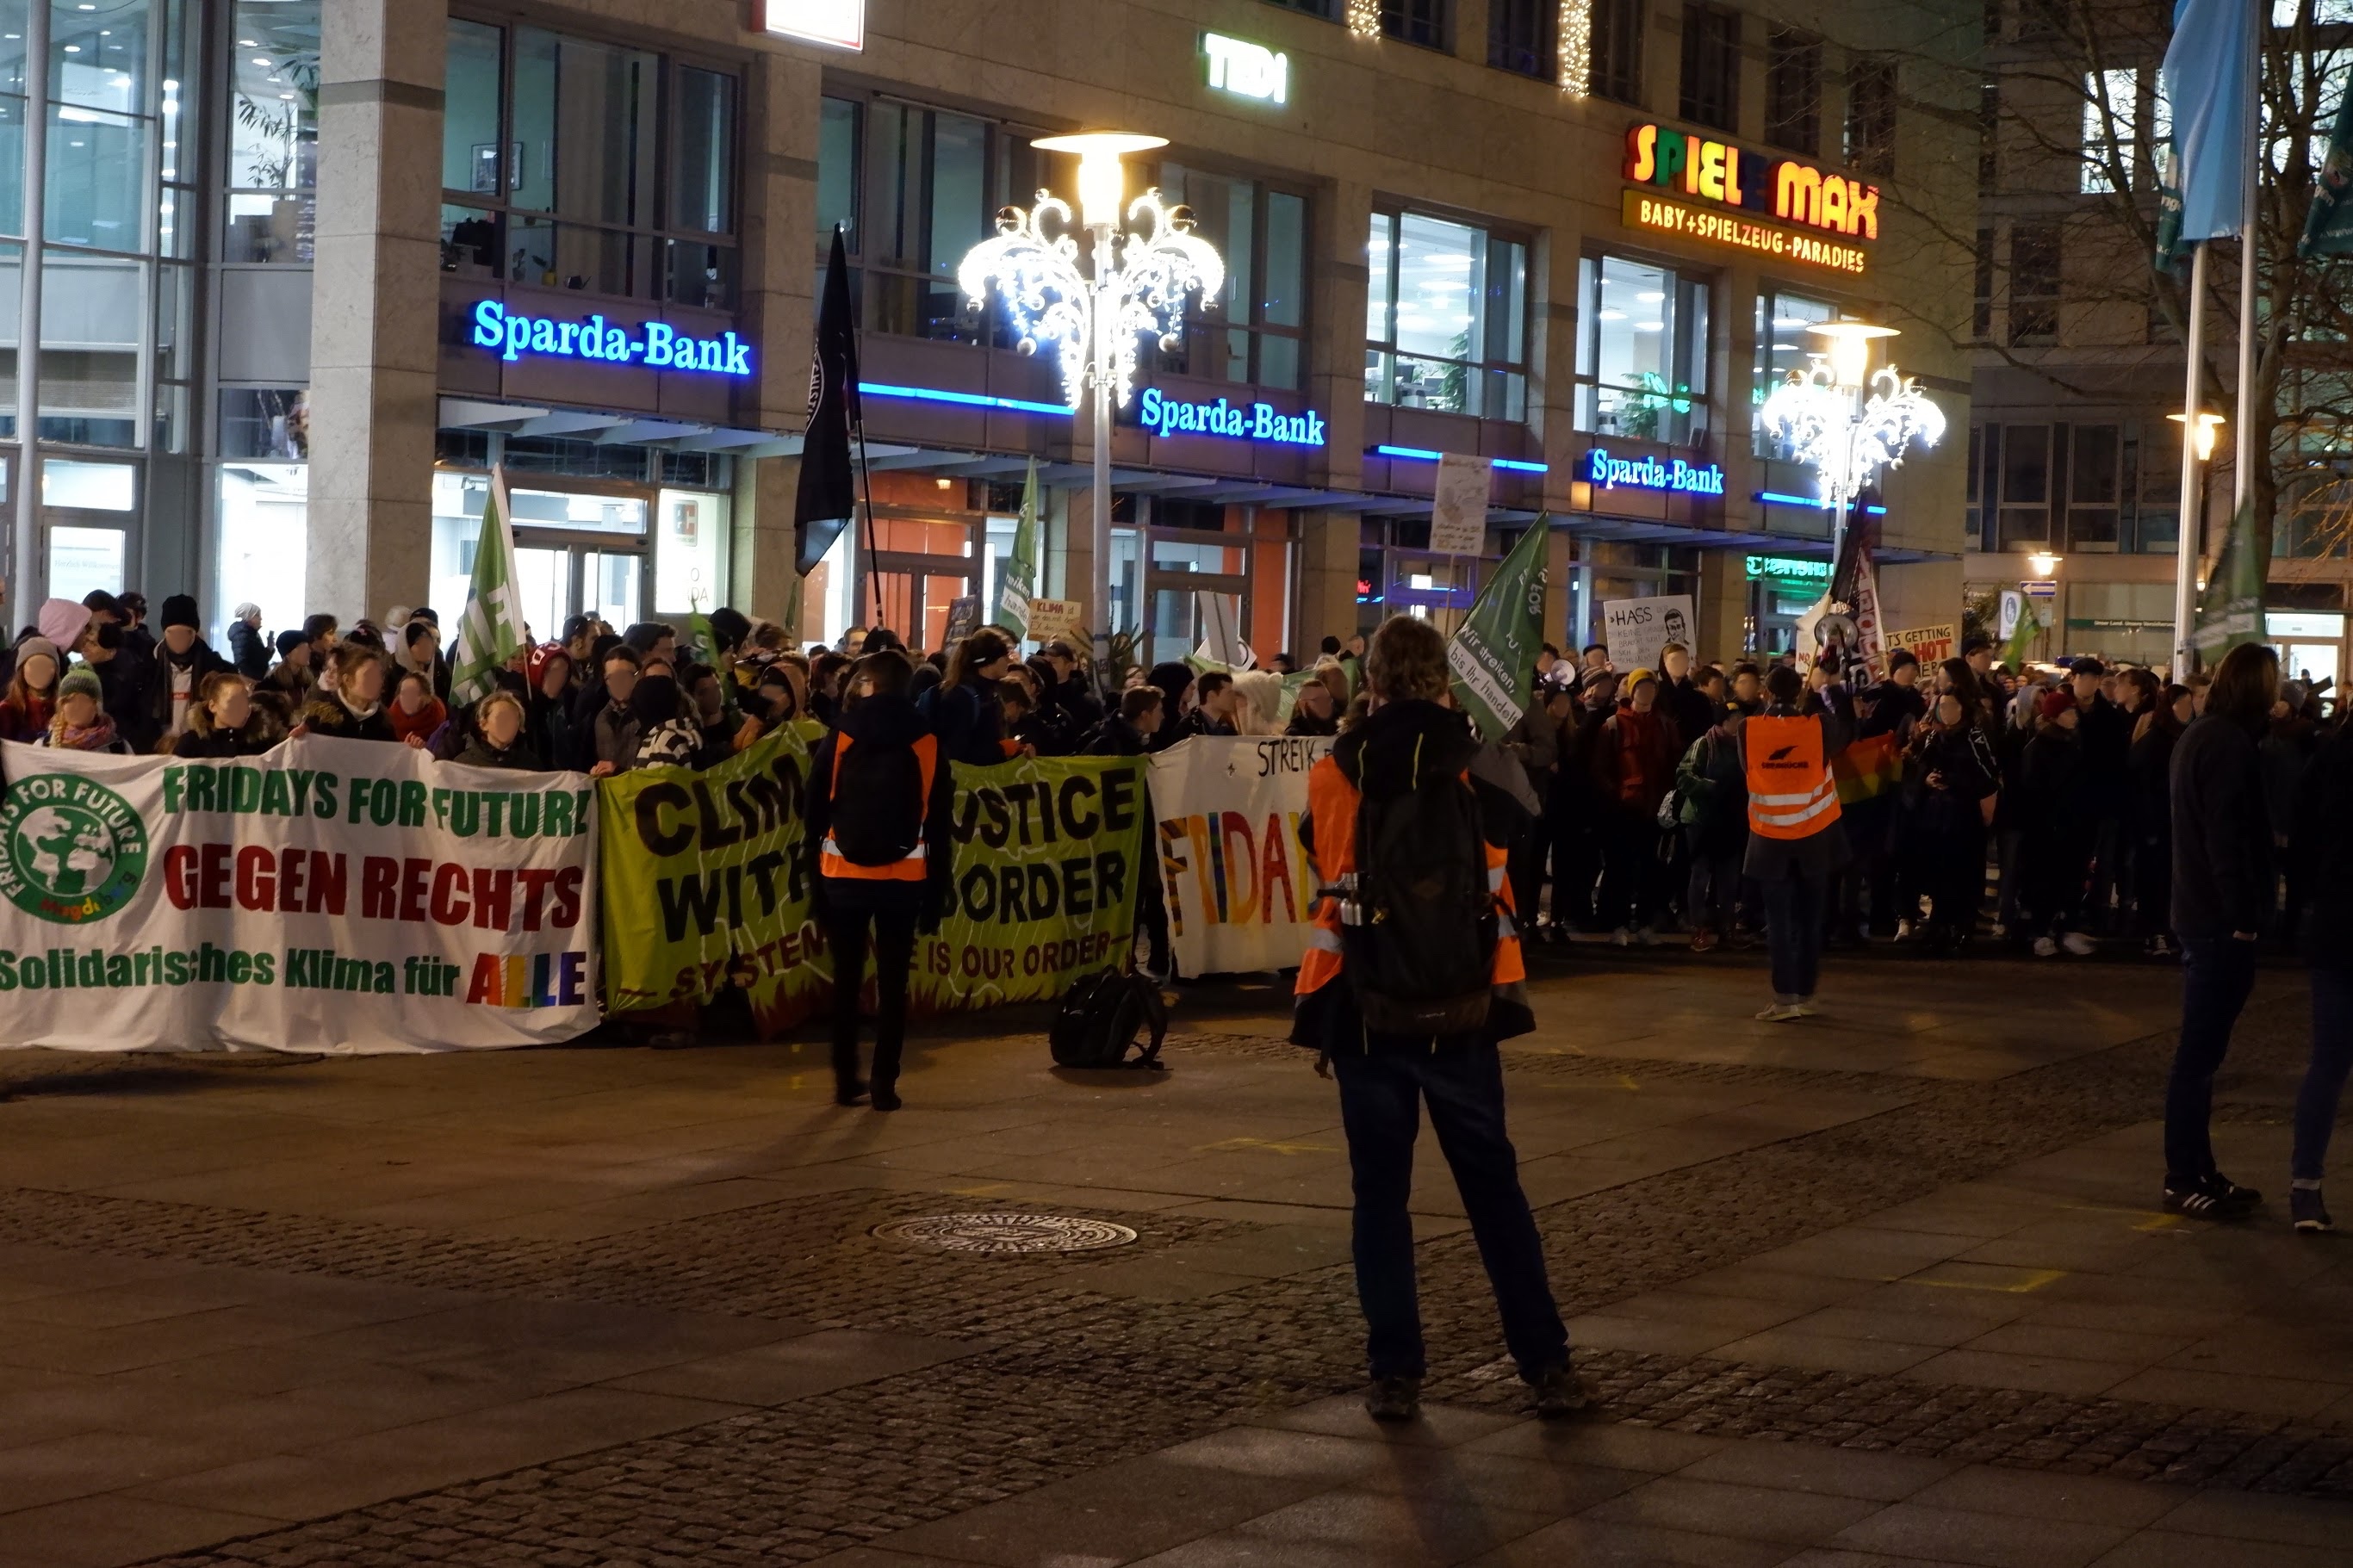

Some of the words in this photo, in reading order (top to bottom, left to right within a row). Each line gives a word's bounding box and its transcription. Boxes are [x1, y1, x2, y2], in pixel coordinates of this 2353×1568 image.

[1776, 160, 1879, 240] MAX
[474, 299, 751, 375] Sparda-Bank
[1141, 387, 1326, 446] Sparda-Bank
[1592, 448, 1724, 495] Sparda-Bank
[1036, 601, 1065, 615] KLIMA
[1617, 627, 1642, 638] KEINE
[1886, 633, 1902, 648] T'S
[1904, 627, 1952, 643] GETTING
[1459, 621, 1481, 648] Wir
[1478, 645, 1517, 694] streiken,
[1913, 638, 1953, 663] HOT
[1450, 647, 1465, 670] bis
[1466, 663, 1481, 685] Ihr
[1481, 680, 1521, 726] handelt
[1257, 739, 1317, 778] STREIK
[16, 778, 67, 805] FOR
[73, 781, 142, 854] FUTURE
[162, 765, 338, 819] FRIDAYS
[348, 777, 427, 827] FOR
[949, 765, 1138, 850] USTICE
[162, 843, 348, 915] GEGEN
[361, 855, 584, 933] RECHTS
[284, 948, 395, 995] Klima
[404, 956, 461, 997] für
[465, 951, 587, 1008] ALLE
[926, 939, 952, 977] IS
[961, 944, 1015, 981] OUR
